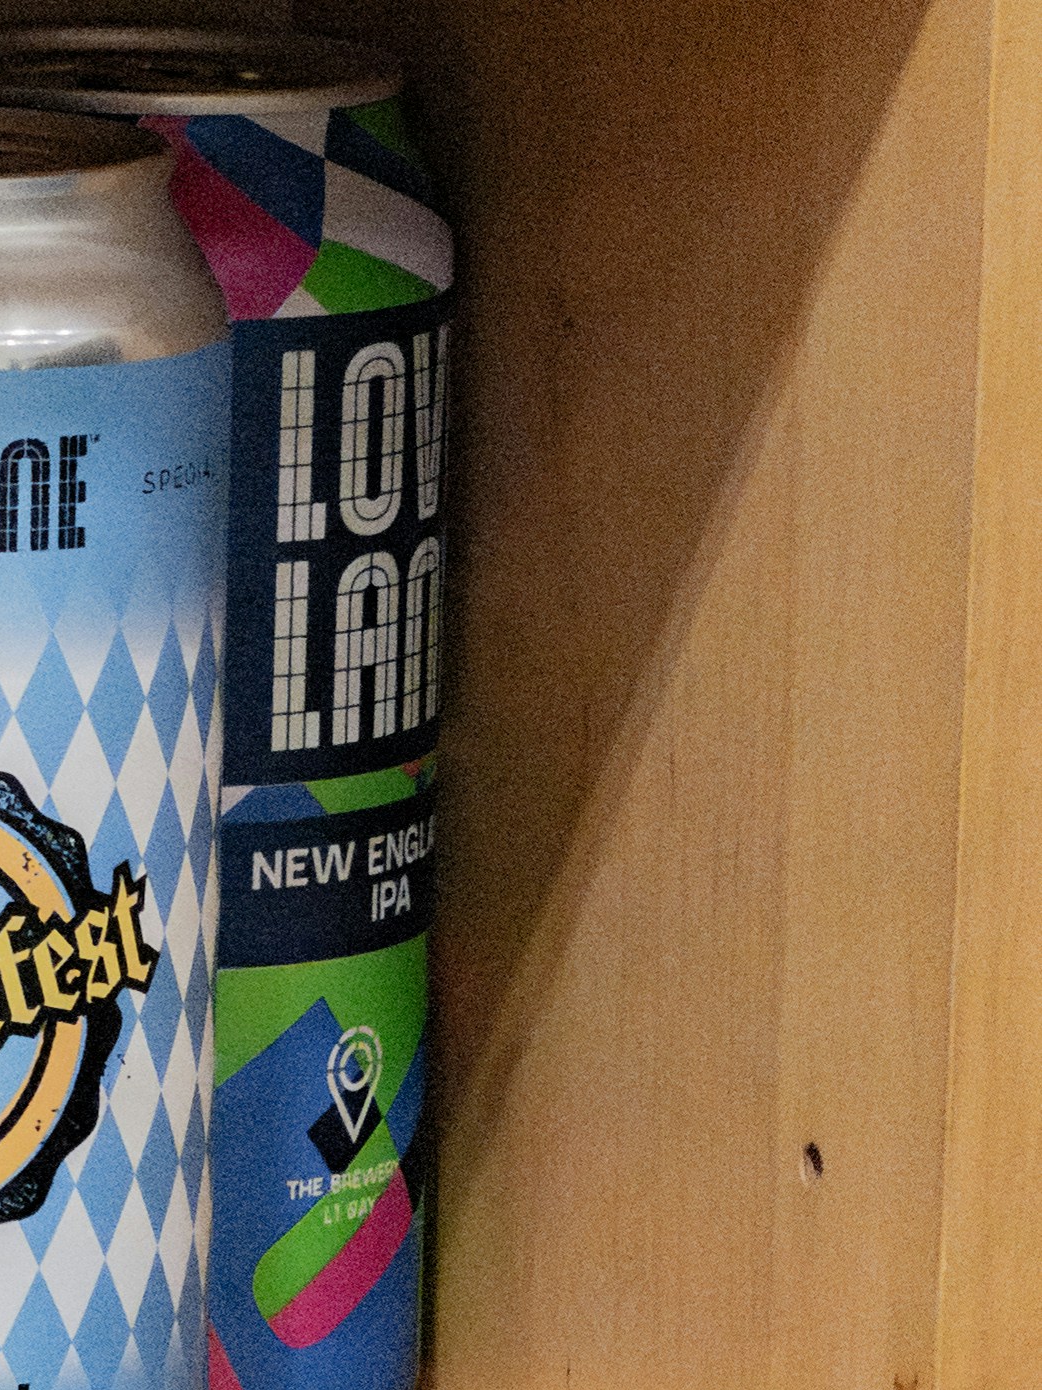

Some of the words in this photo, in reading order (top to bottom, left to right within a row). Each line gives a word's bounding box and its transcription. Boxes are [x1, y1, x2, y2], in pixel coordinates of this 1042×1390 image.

[252, 841, 355, 891] NEW
[371, 874, 411, 923] IPA
[286, 1177, 324, 1201] THE
